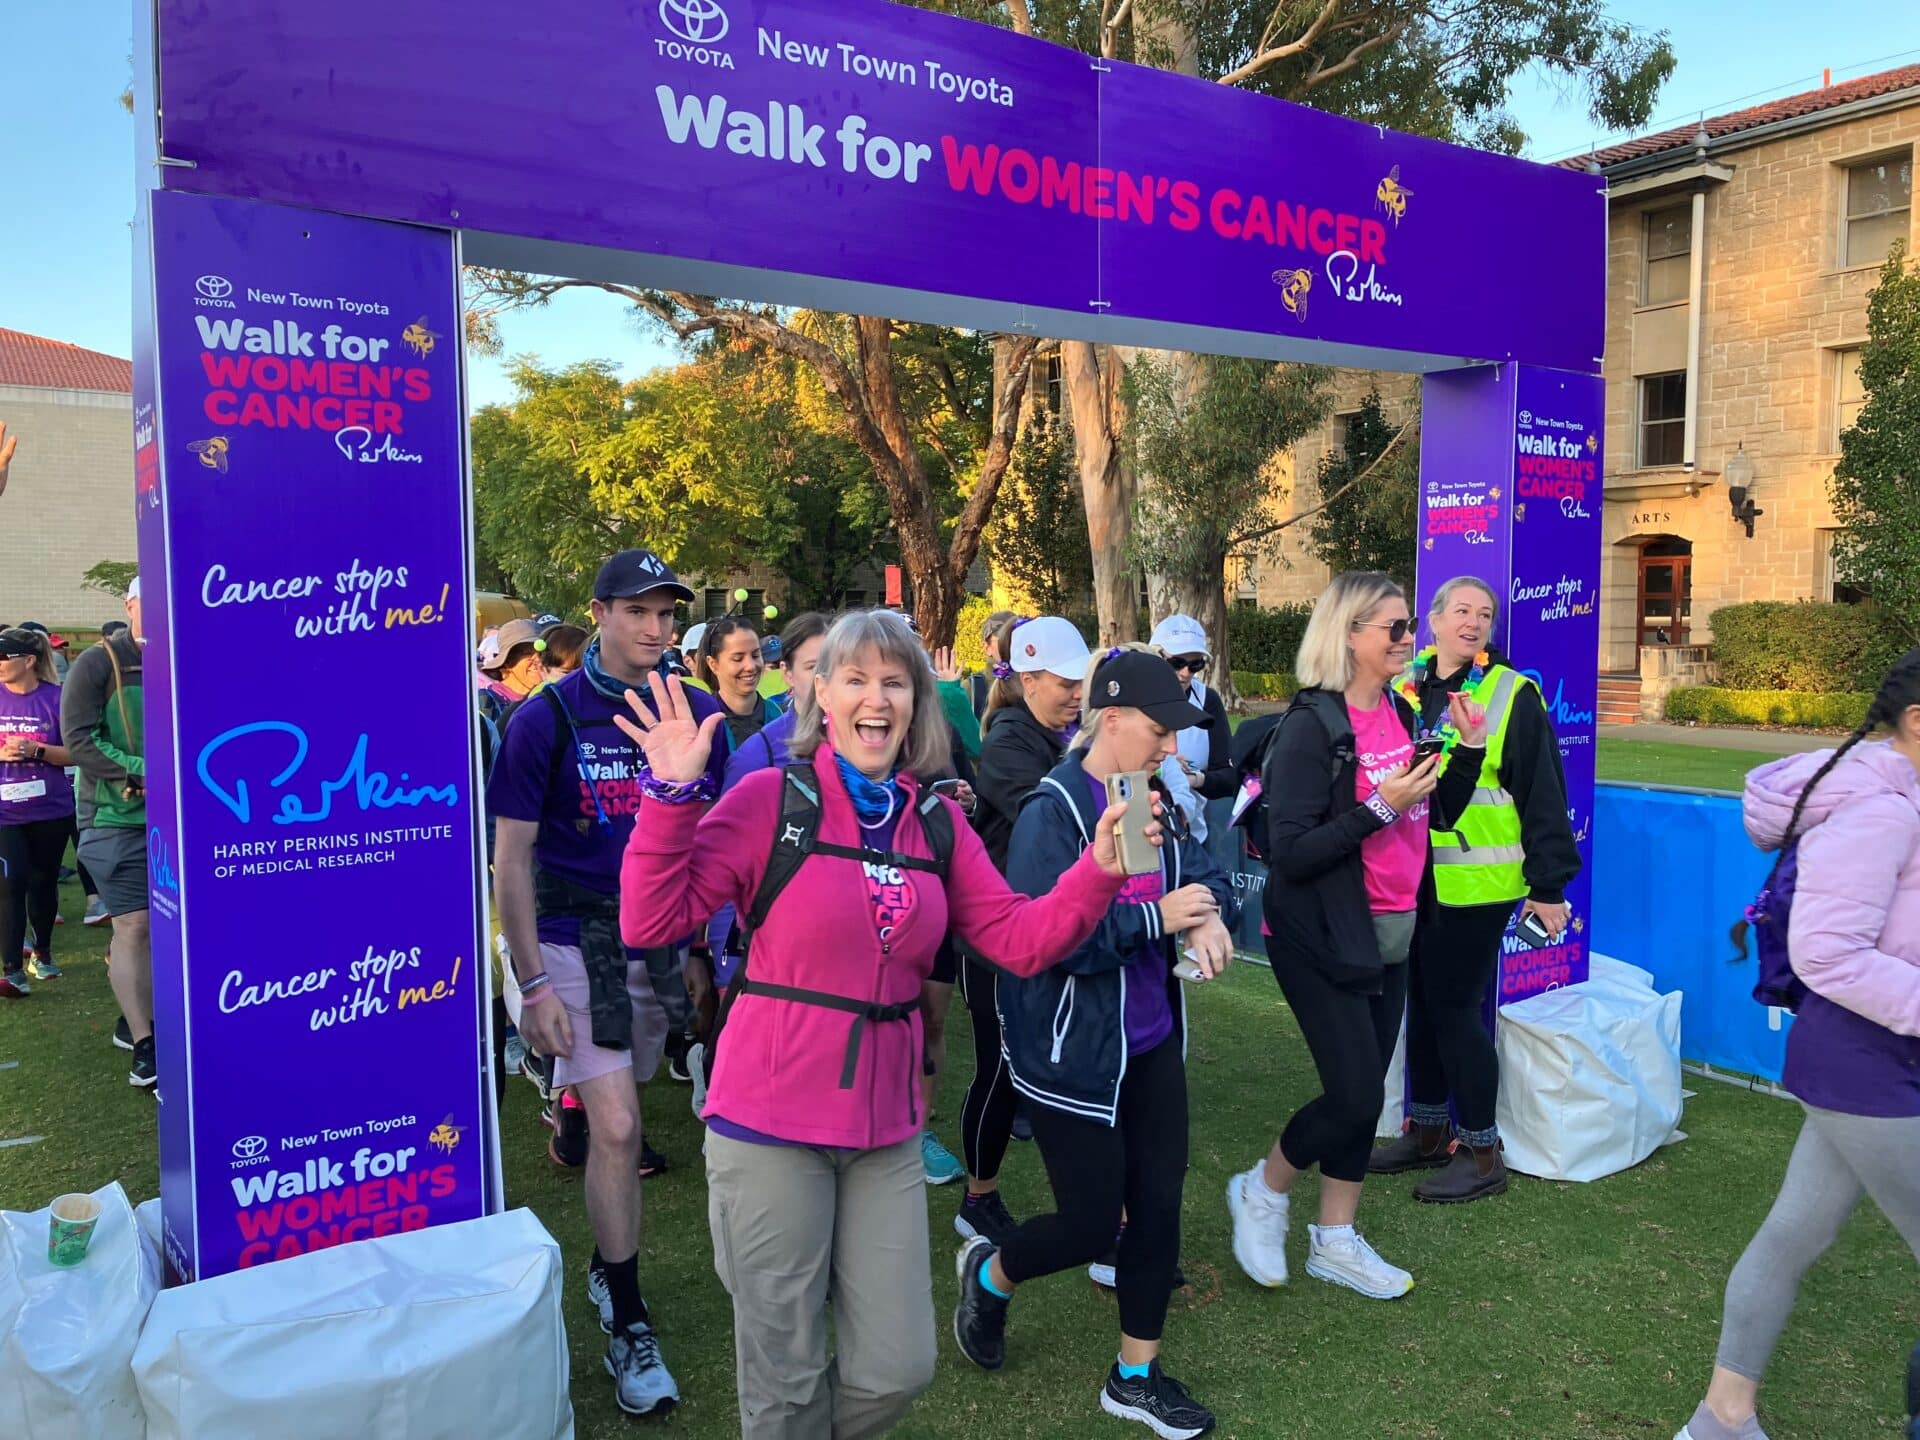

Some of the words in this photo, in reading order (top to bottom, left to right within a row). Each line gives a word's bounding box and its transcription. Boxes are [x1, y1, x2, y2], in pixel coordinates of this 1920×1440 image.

[654, 38, 735, 71] TOYOTA
[757, 27, 829, 68] New
[837, 43, 917, 86] Town
[924, 59, 1015, 107] Toyota
[655, 84, 826, 167] Walk
[837, 116, 932, 183] for
[940, 134, 1200, 231] WOMEN'S
[1210, 188, 1387, 264] CANCER
[1326, 250, 1402, 306] Perkins
[193, 297, 236, 309] TOYOTA
[247, 288, 286, 304] New
[289, 292, 333, 310] Town
[337, 297, 389, 315] Toyota
[194, 315, 315, 357] Walk
[320, 324, 389, 362] for
[200, 351, 432, 401] WOMEN'S
[203, 390, 404, 434] CANCER
[1536, 417, 1549, 426] New
[1550, 419, 1565, 428] Town
[1565, 421, 1584, 431] Toyota
[1518, 433, 1557, 456] Walk
[1559, 437, 1582, 459] for
[1519, 456, 1595, 481] WOMEN'S
[1427, 493, 1460, 508] Walk
[1462, 493, 1485, 506] for
[1518, 476, 1584, 500] CANCER
[1427, 519, 1488, 534] CANCER
[1428, 505, 1498, 520] WOMEN'S
[1632, 512, 1671, 525] ARTS
[202, 564, 322, 608] Cancer
[334, 558, 409, 611] stops
[1512, 576, 1553, 603] Cancer
[1556, 574, 1582, 600] stops
[294, 593, 376, 639] with
[384, 583, 450, 629] me!
[1541, 599, 1569, 622] with
[1571, 590, 1596, 616] me!
[18, 723, 38, 733] for
[1559, 736, 1590, 746] INSTITUTE
[601, 746, 618, 754] New
[197, 720, 458, 825] Perkins
[577, 761, 629, 780] Walk
[214, 840, 277, 859] HARRY
[284, 833, 359, 854] PERKINS
[365, 825, 453, 846] INSTITUTE
[214, 865, 238, 879] OF
[242, 858, 313, 877] MEDICAL
[318, 850, 396, 869] RESEARCH
[1504, 942, 1581, 973] WOMEN'S
[218, 967, 337, 1014] Cancer
[348, 945, 421, 994] stops
[309, 978, 389, 1031] with
[397, 957, 461, 1009] me!
[1504, 965, 1570, 995] CANCER
[281, 1134, 318, 1151] New
[321, 1125, 363, 1143] Town
[366, 1114, 417, 1137] Toyota
[230, 1155, 270, 1169] TOYOTA
[230, 1156, 345, 1208] Walk
[350, 1146, 417, 1182] for
[235, 1164, 457, 1242] WOMEN'S
[238, 1204, 429, 1270] CANCER
